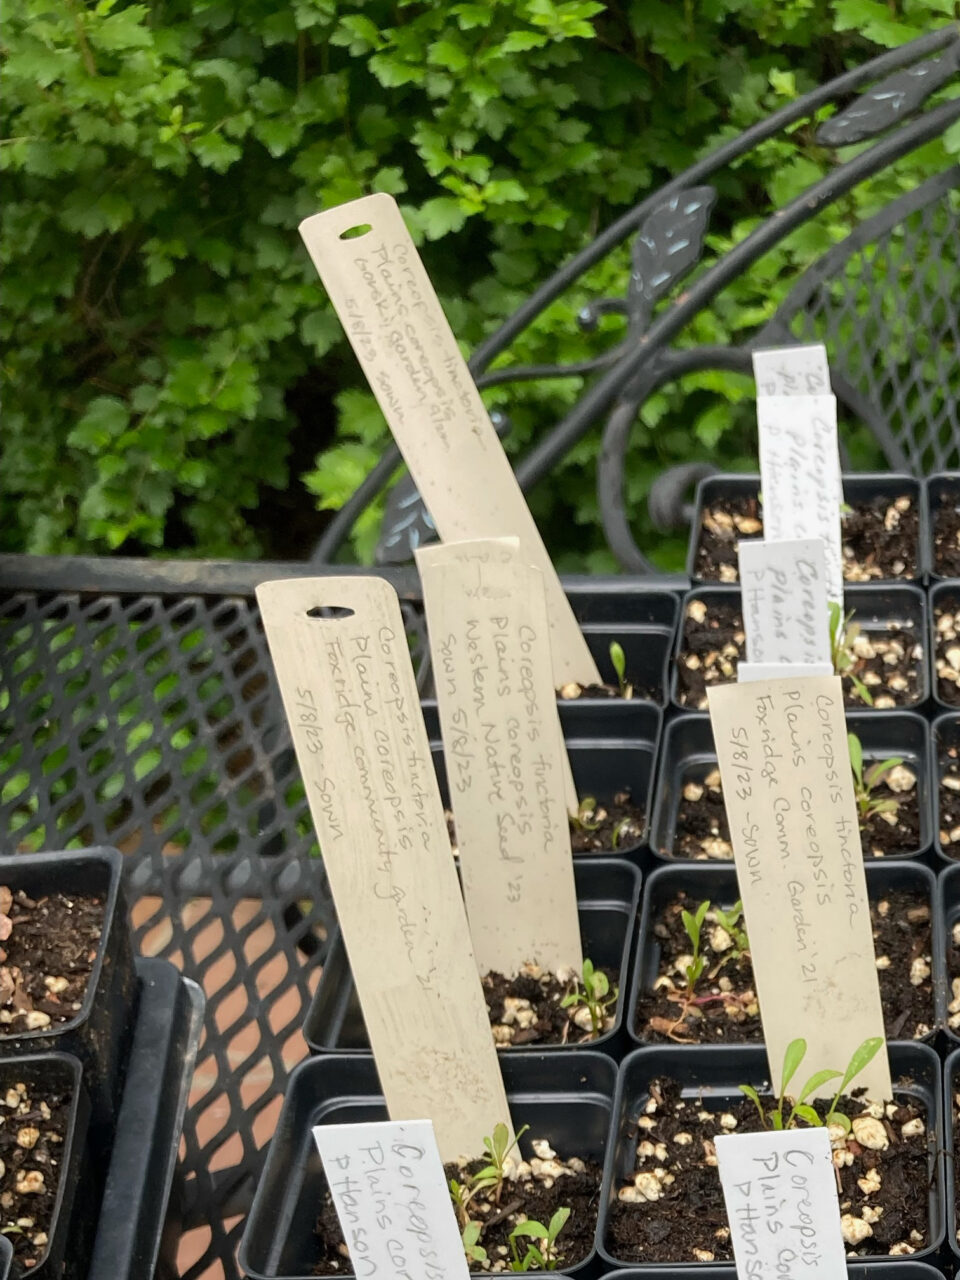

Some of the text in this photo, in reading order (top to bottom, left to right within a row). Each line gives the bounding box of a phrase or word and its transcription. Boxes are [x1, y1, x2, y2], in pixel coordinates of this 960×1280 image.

[370, 241, 409, 316] Plains
[324, 635, 362, 737] Foxridge
[349, 634, 380, 717] Plains
[488, 615, 521, 697] Plains
[516, 623, 543, 743] Coreopsis
[295, 685, 344, 841] 5/8/23 Sown
[376, 624, 433, 852] Coreopsis tinctoria
[439, 632, 475, 794] Sown 5/8/23
[464, 618, 489, 717] Western
[479, 722, 506, 804] Native
[495, 811, 525, 864] Seed
[728, 726, 754, 801] 5/8/23
[781, 689, 812, 768] Plains
[754, 693, 784, 788] Foxridge
[785, 879, 810, 952] Garden
[814, 693, 864, 929] Coreopsis tinctoria
[332, 1175, 377, 1279] Hanson
[358, 1140, 392, 1230] Plains
[390, 1143, 444, 1280] Coreopsis
[751, 1151, 786, 1234] Plains
[782, 1149, 822, 1266] Coreopsis
